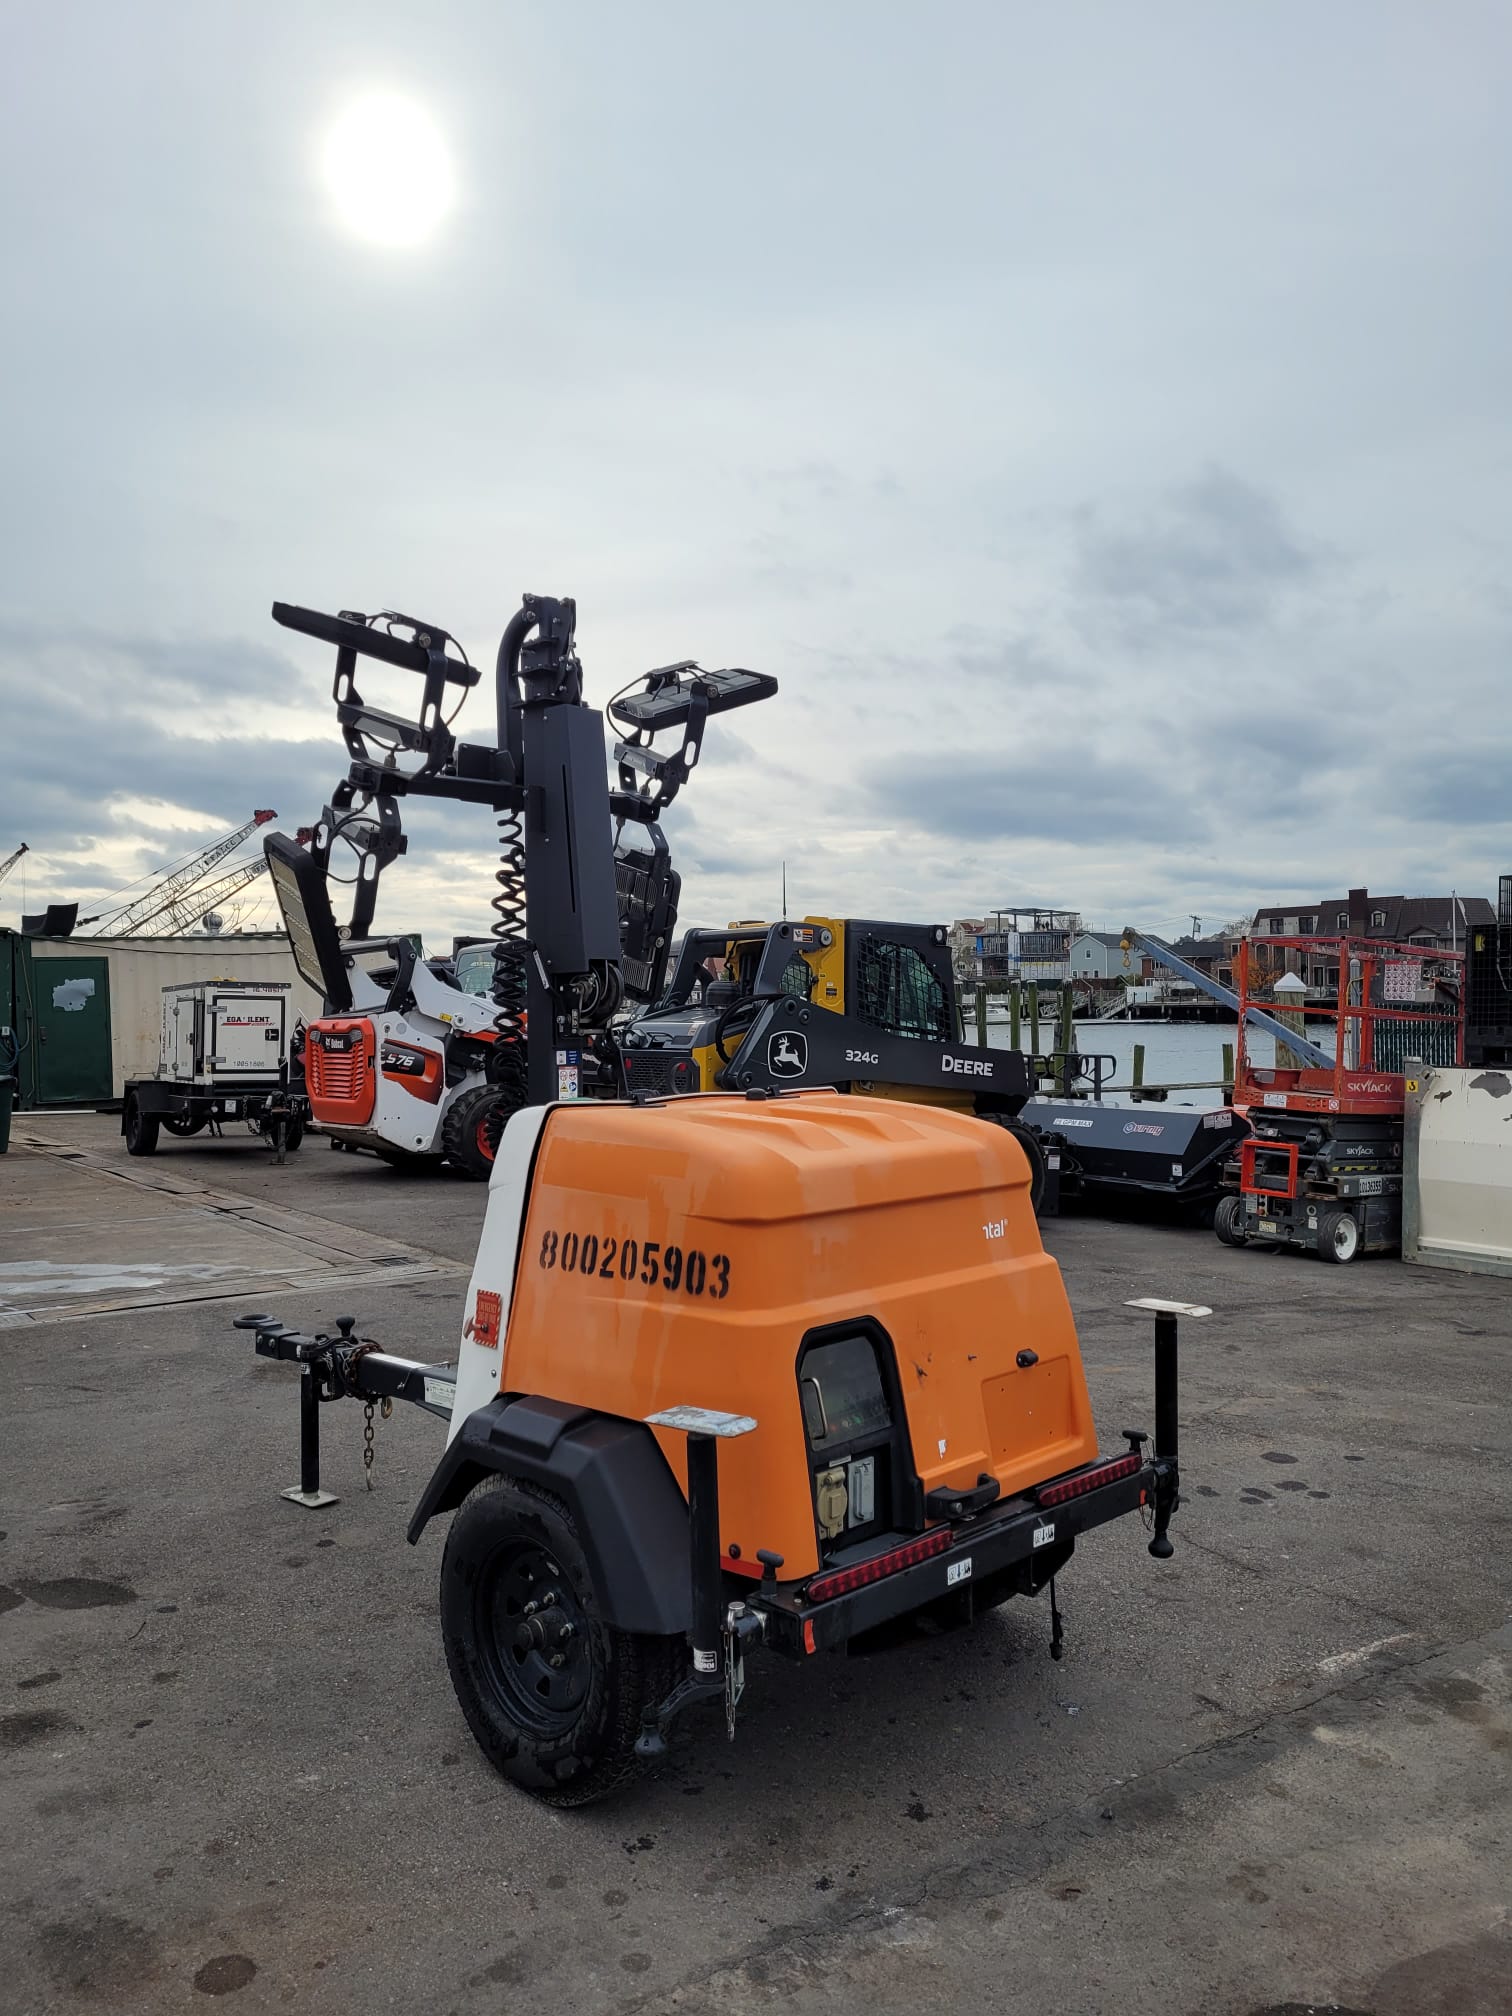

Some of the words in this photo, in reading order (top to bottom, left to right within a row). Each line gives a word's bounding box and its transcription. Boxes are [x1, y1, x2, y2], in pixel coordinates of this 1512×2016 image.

[386, 1053, 415, 1067] S76
[845, 1050, 879, 1065] 324G
[941, 1054, 994, 1077] DEERE
[1347, 1079, 1392, 1094] SKYJACK
[1346, 1145, 1375, 1156] SKYJACK
[539, 1230, 731, 1300] 800205903
